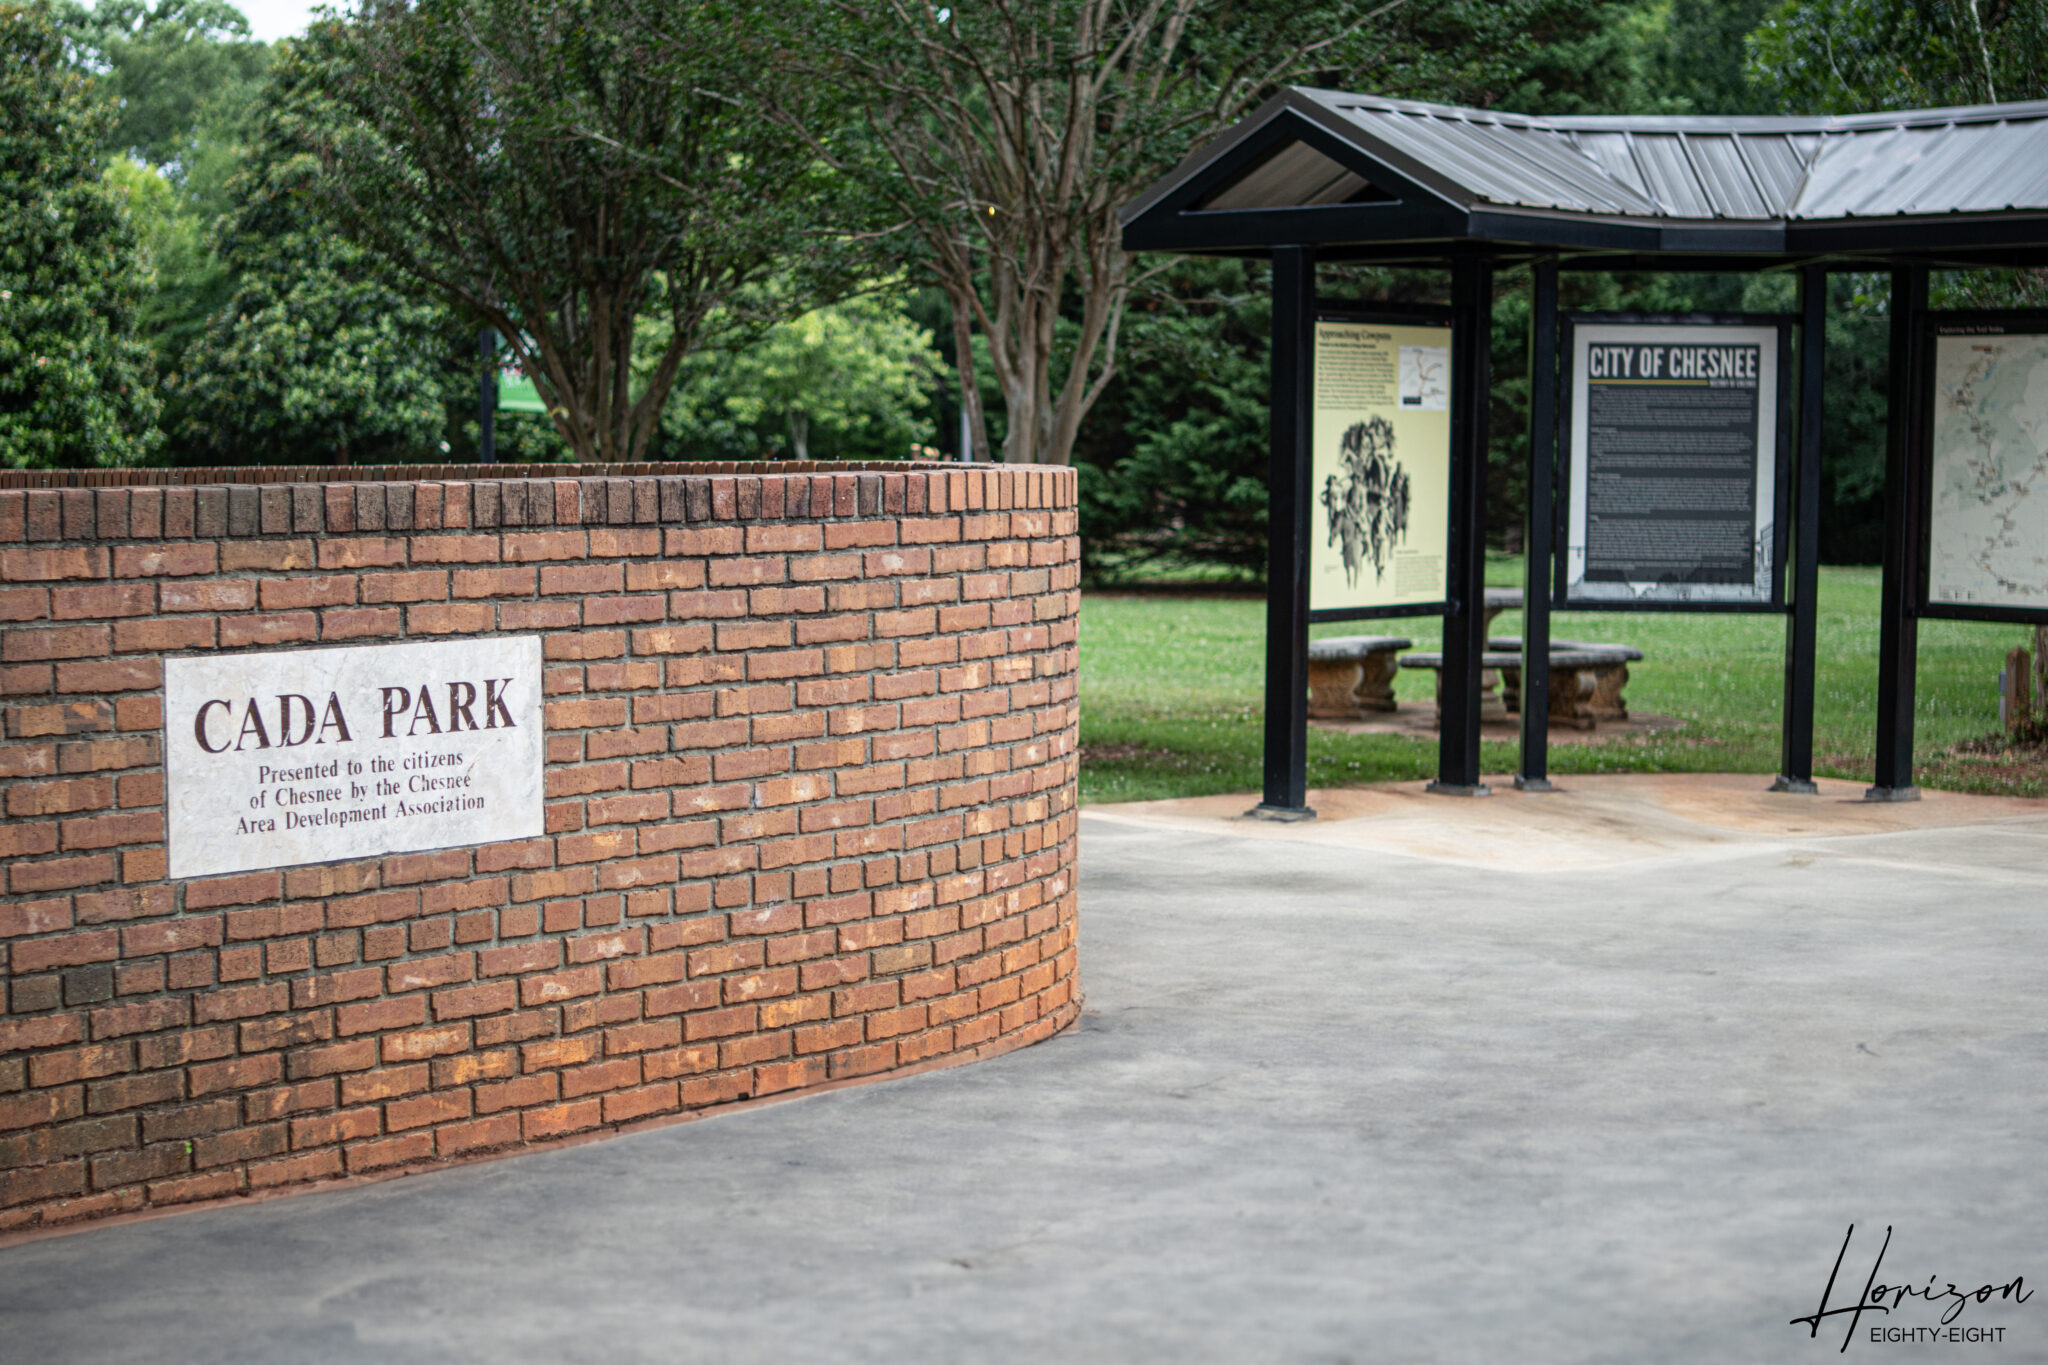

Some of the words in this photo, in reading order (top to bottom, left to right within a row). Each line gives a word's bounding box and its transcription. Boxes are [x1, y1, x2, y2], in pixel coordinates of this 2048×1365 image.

[1590, 346, 1633, 378] CITY
[1639, 346, 1664, 378] OF
[1669, 347, 1757, 378] CHESNEE
[194, 691, 352, 754] CADA
[378, 677, 517, 739] PARK
[259, 759, 338, 784] Presented
[347, 760, 363, 776] to
[371, 755, 396, 774] the
[403, 750, 464, 770] citizens
[249, 790, 267, 810] of
[275, 787, 342, 807] Chesnee
[351, 781, 368, 802] by
[376, 778, 401, 796] the
[408, 774, 472, 793] Chesnee
[235, 816, 276, 836] Area
[285, 802, 387, 829] Development
[395, 793, 485, 818] Association
